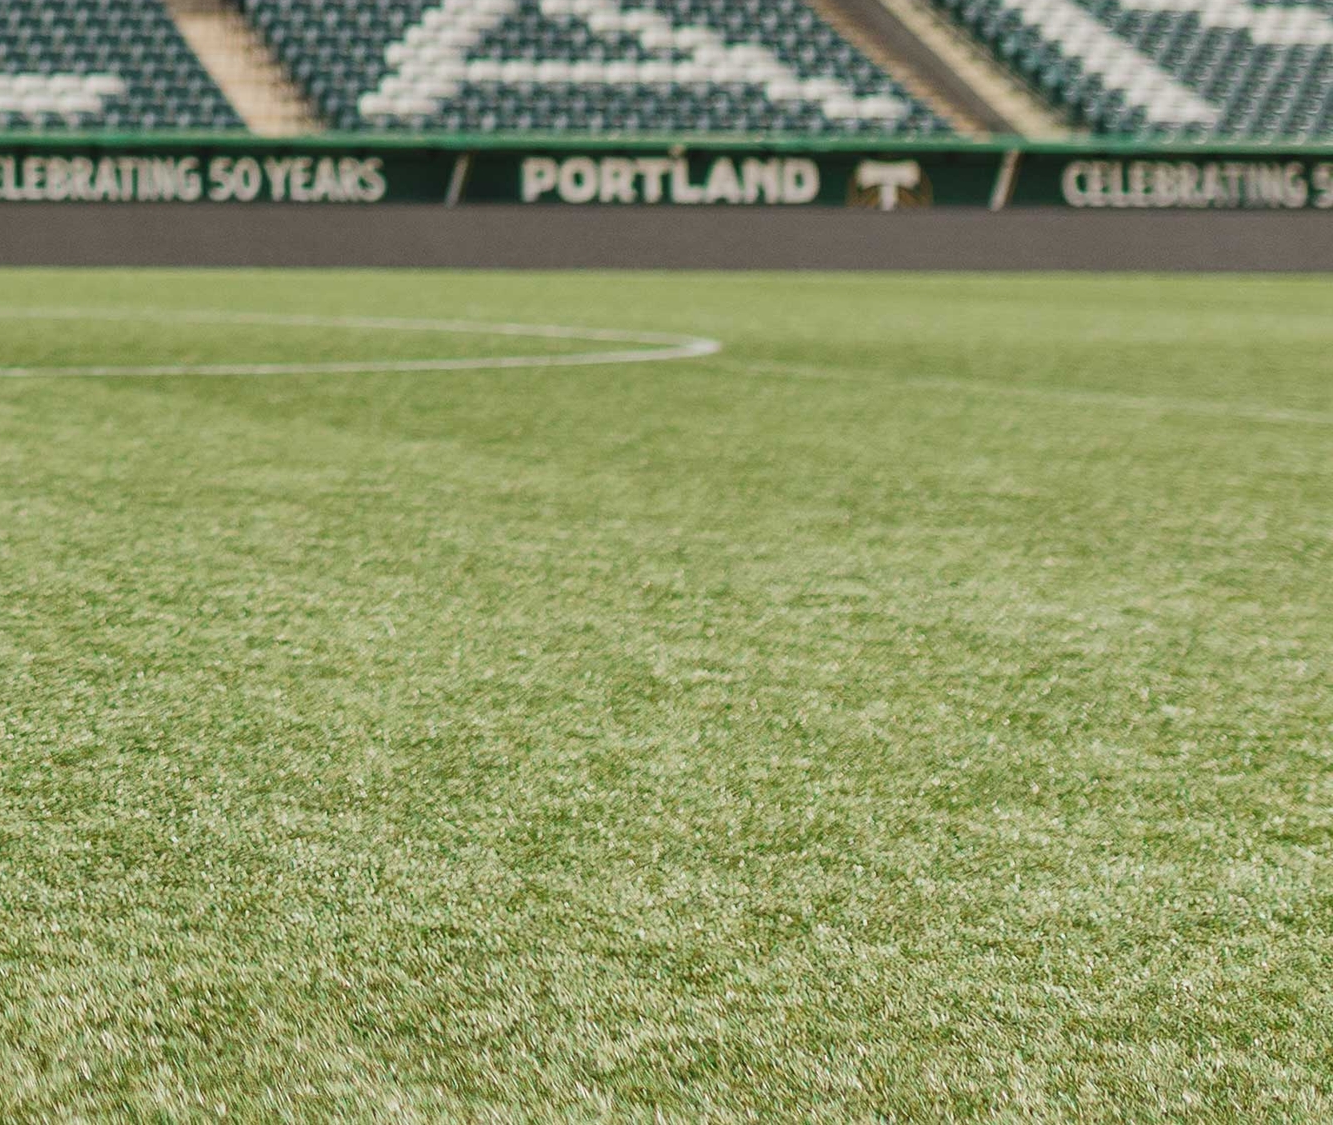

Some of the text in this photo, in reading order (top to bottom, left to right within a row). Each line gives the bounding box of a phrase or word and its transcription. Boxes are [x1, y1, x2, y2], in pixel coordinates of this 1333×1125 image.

[209, 156, 267, 202] 50
[268, 157, 387, 204] YEARS
[521, 155, 820, 205] PORTLAND
[1061, 158, 1309, 209] CELEBRATING
